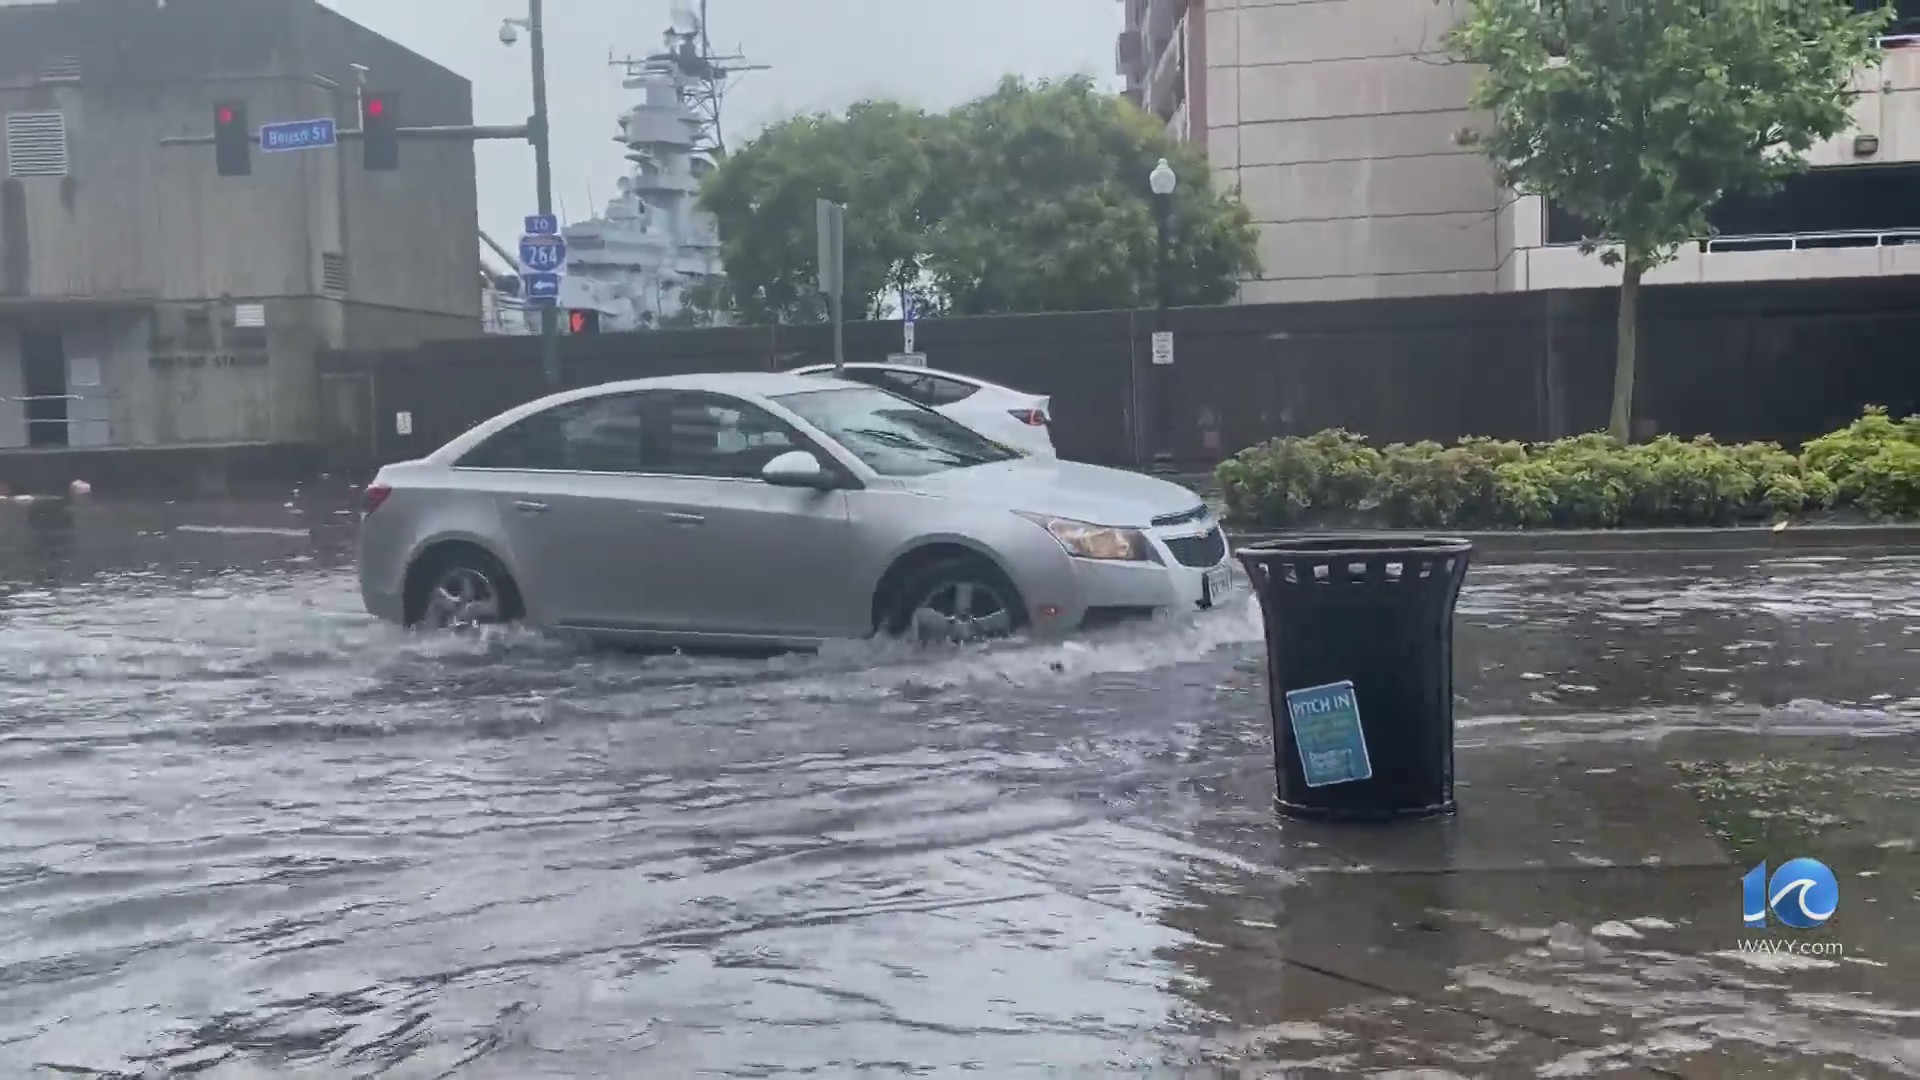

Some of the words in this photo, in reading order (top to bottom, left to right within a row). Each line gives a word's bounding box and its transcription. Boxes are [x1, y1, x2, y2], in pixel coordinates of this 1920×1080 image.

[528, 245, 557, 265] 264
[1293, 697, 1331, 718] PITCH
[1333, 693, 1351, 709] IN
